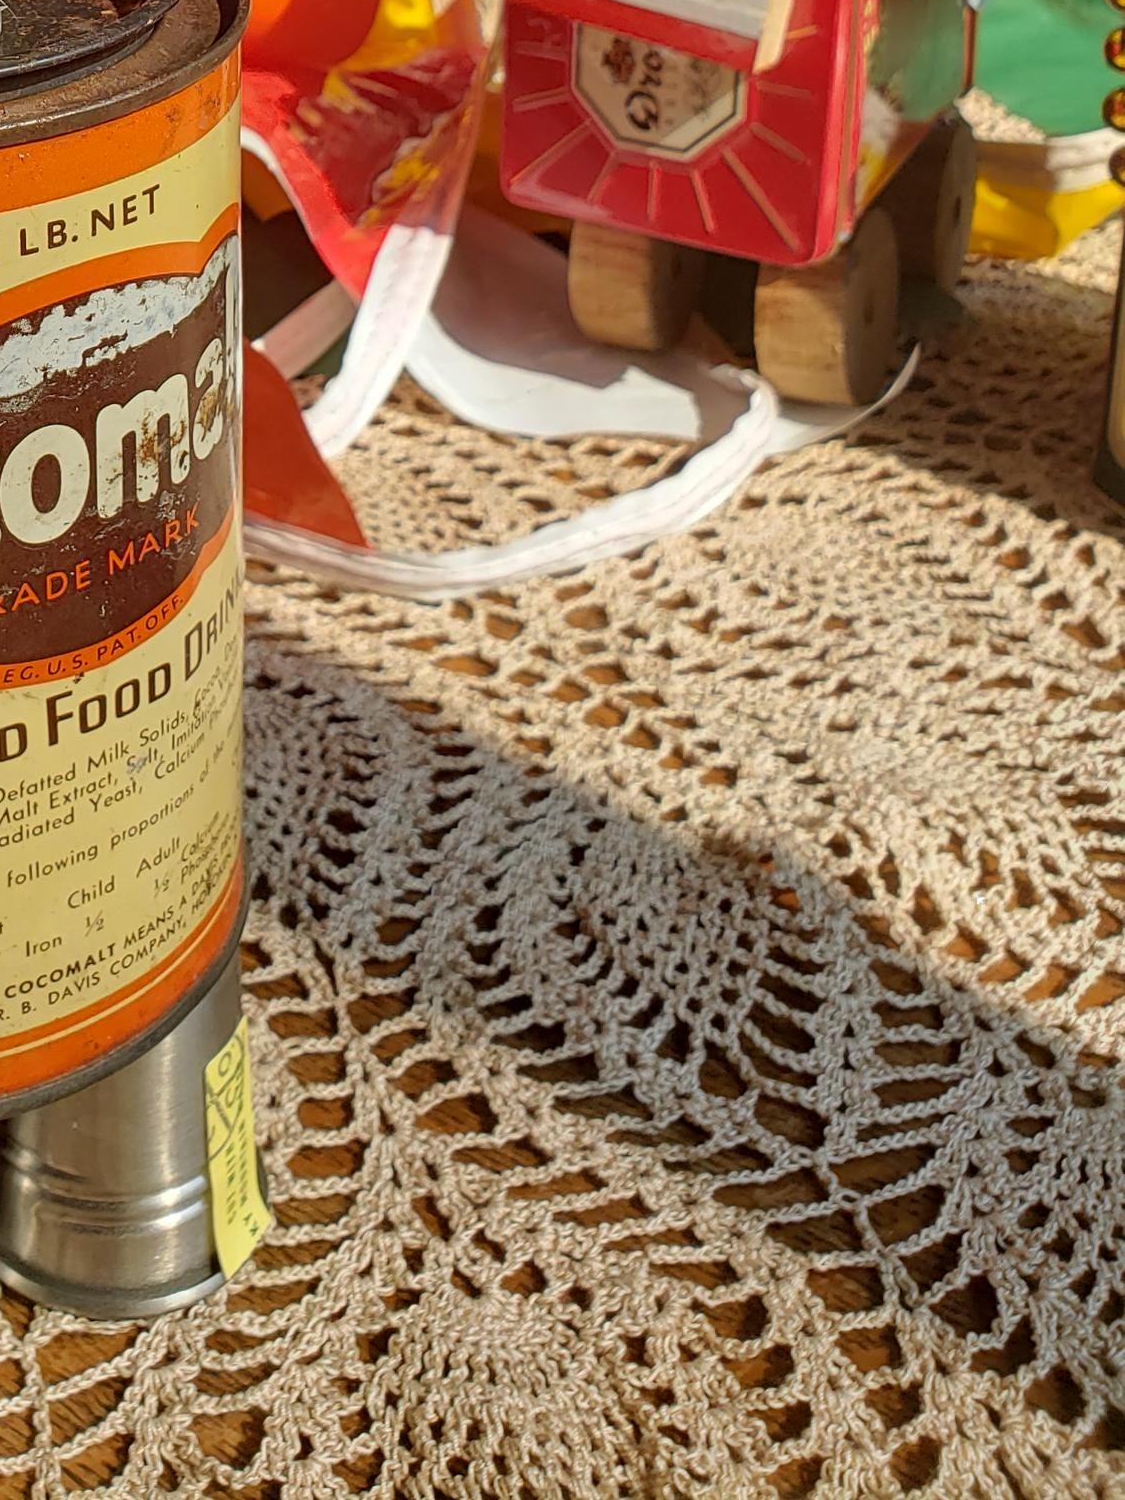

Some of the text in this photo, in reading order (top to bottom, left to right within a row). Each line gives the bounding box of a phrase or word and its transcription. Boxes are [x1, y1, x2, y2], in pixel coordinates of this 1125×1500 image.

[19, 219, 79, 257] LB.
[90, 184, 162, 237] NET
[107, 507, 200, 574] MARK
[97, 628, 141, 661] PAT.
[145, 595, 184, 631] OFF.
[46, 662, 172, 747] FOOD
[87, 740, 130, 773] Milk
[139, 710, 189, 747] Solids,
[89, 778, 143, 812] Yeast,
[154, 732, 205, 780] Calcium
[49, 772, 119, 810] Extract,
[7, 844, 98, 888] following
[110, 783, 195, 851] proportions
[67, 875, 115, 909] Child
[135, 836, 181, 879] Adult
[4, 942, 116, 999] COCOMALT
[123, 905, 174, 949] MEANS
[179, 895, 187, 910] A
[25, 936, 63, 957] Iron
[21, 1000, 37, 1015] B.
[48, 971, 101, 1005] DAVIS
